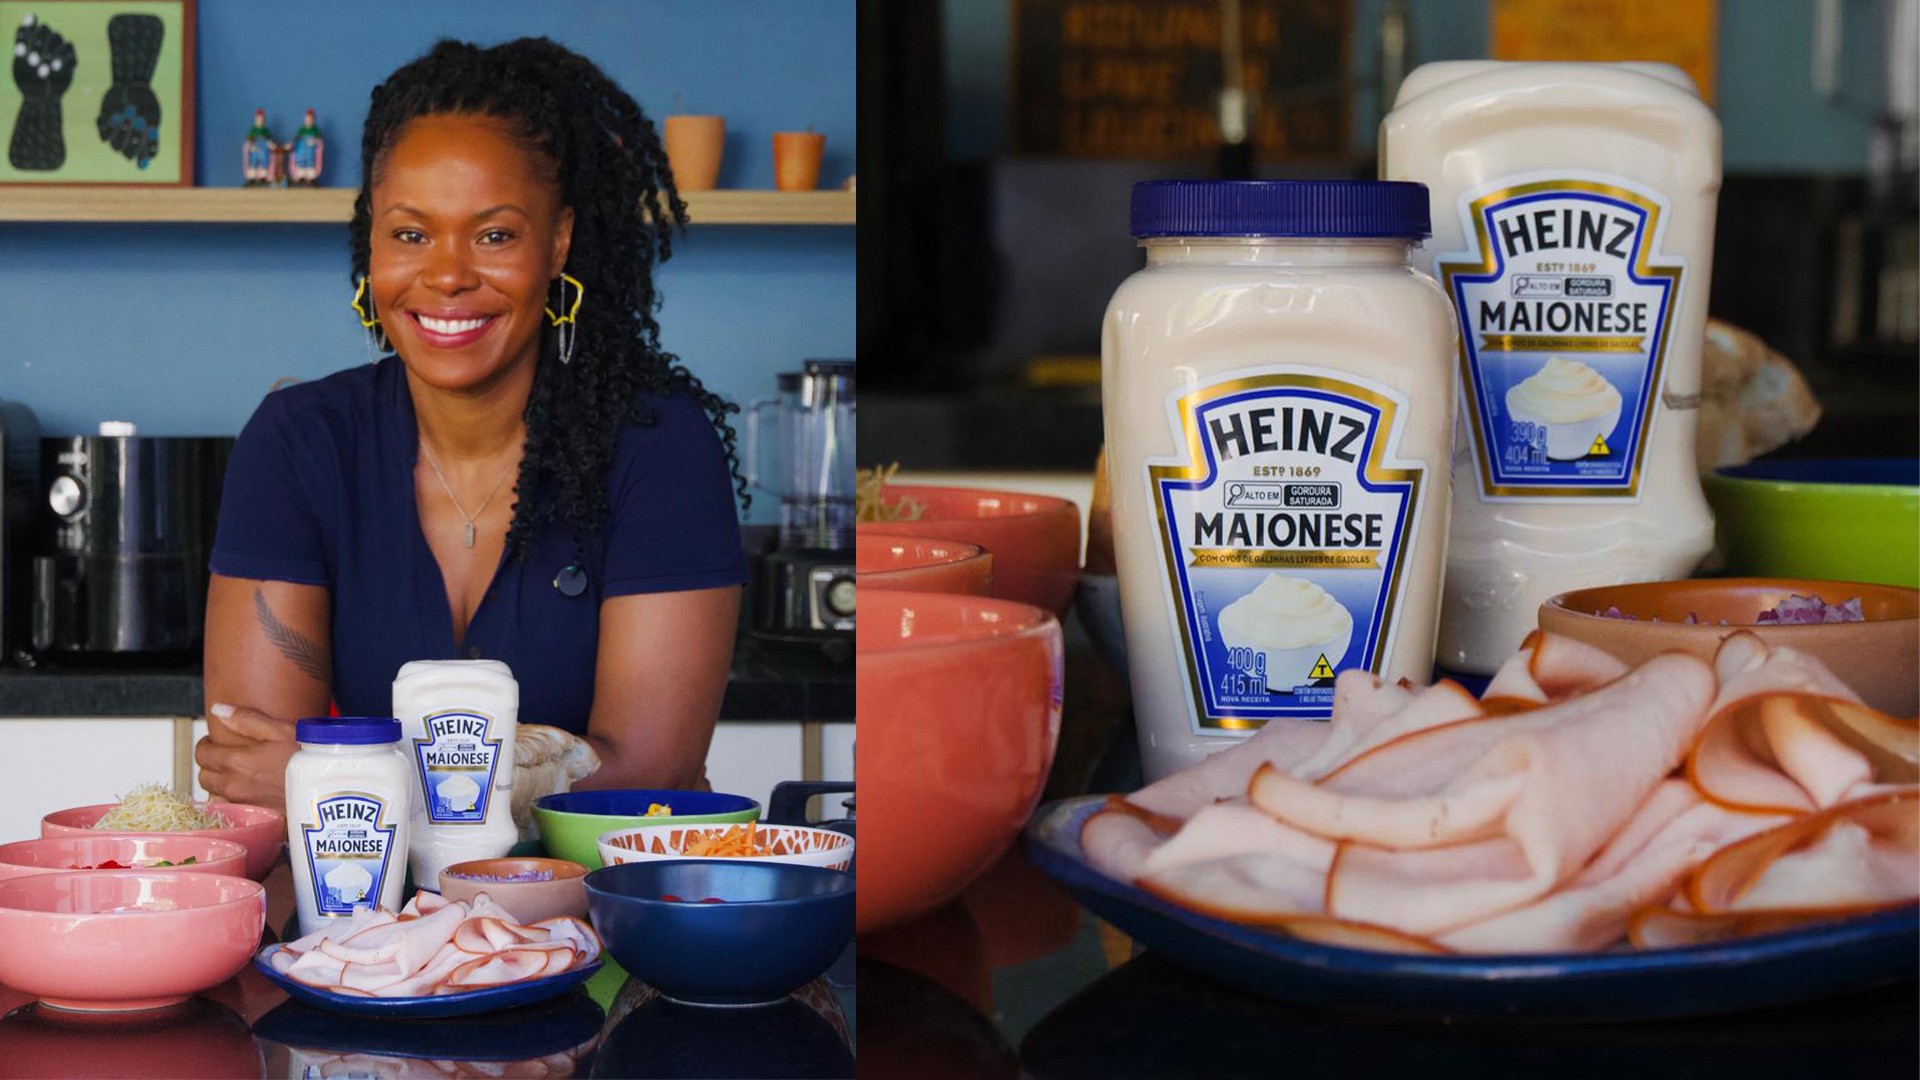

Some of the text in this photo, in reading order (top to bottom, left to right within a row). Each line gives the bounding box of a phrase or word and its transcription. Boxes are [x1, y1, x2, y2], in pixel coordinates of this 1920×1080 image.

[1498, 208, 1636, 260] HEINZ
[1568, 262, 1597, 272] 1869
[1480, 300, 1648, 333] MAIONESE
[1208, 406, 1366, 464] HEINZ
[1512, 422, 1547, 447] 390 g
[1505, 446, 1551, 465] 404 mL
[1289, 466, 1321, 477] 1869
[1244, 491, 1280, 501] ALTO EM
[1291, 485, 1333, 496] GORDURA
[1289, 496, 1334, 506] SATURADA
[1194, 512, 1383, 548] MAIONESE
[1199, 554, 1218, 562] COM
[1219, 555, 1241, 563] OVOS
[1243, 555, 1253, 563] DE
[1227, 648, 1265, 673] 400 g
[1221, 674, 1270, 695] 415 mL
[433, 719, 484, 737] HEINZ
[426, 752, 490, 765] MAIONESE
[322, 803, 376, 823] HEINZ
[316, 840, 383, 852] MAIONESE
